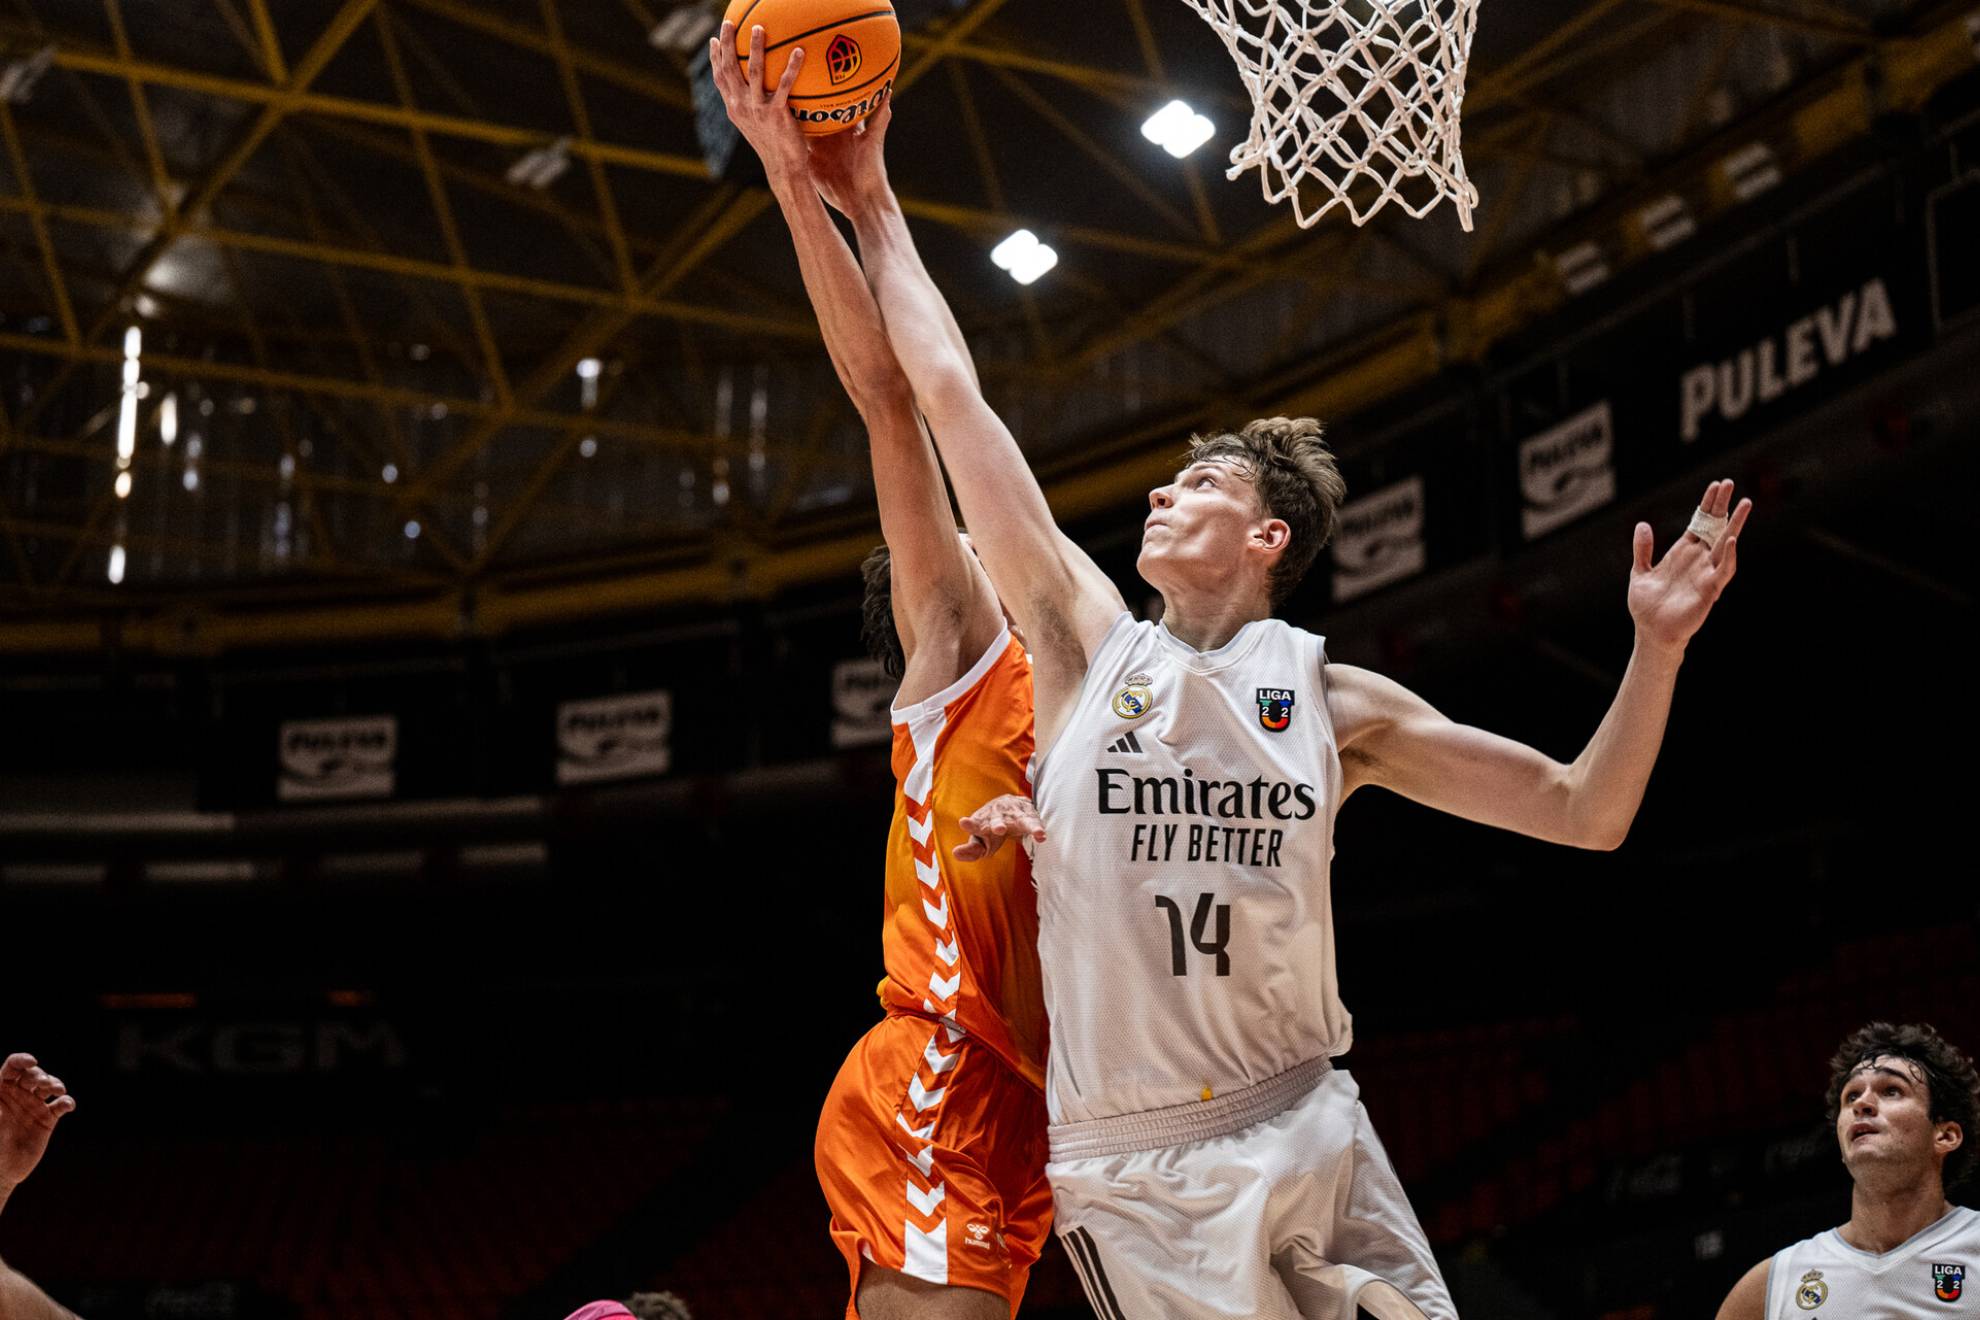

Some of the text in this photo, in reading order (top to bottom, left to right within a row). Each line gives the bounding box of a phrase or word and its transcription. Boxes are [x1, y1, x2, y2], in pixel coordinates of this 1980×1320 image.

[1680, 277, 1897, 443] PULEVA
[1259, 689, 1292, 701] LIGA
[1096, 768, 1316, 820] Emirates
[1131, 824, 1284, 867] FLY BETTER
[1154, 892, 1231, 977] 14
[114, 1017, 406, 1073] KGM
[1934, 1265, 1962, 1276] LIGA
